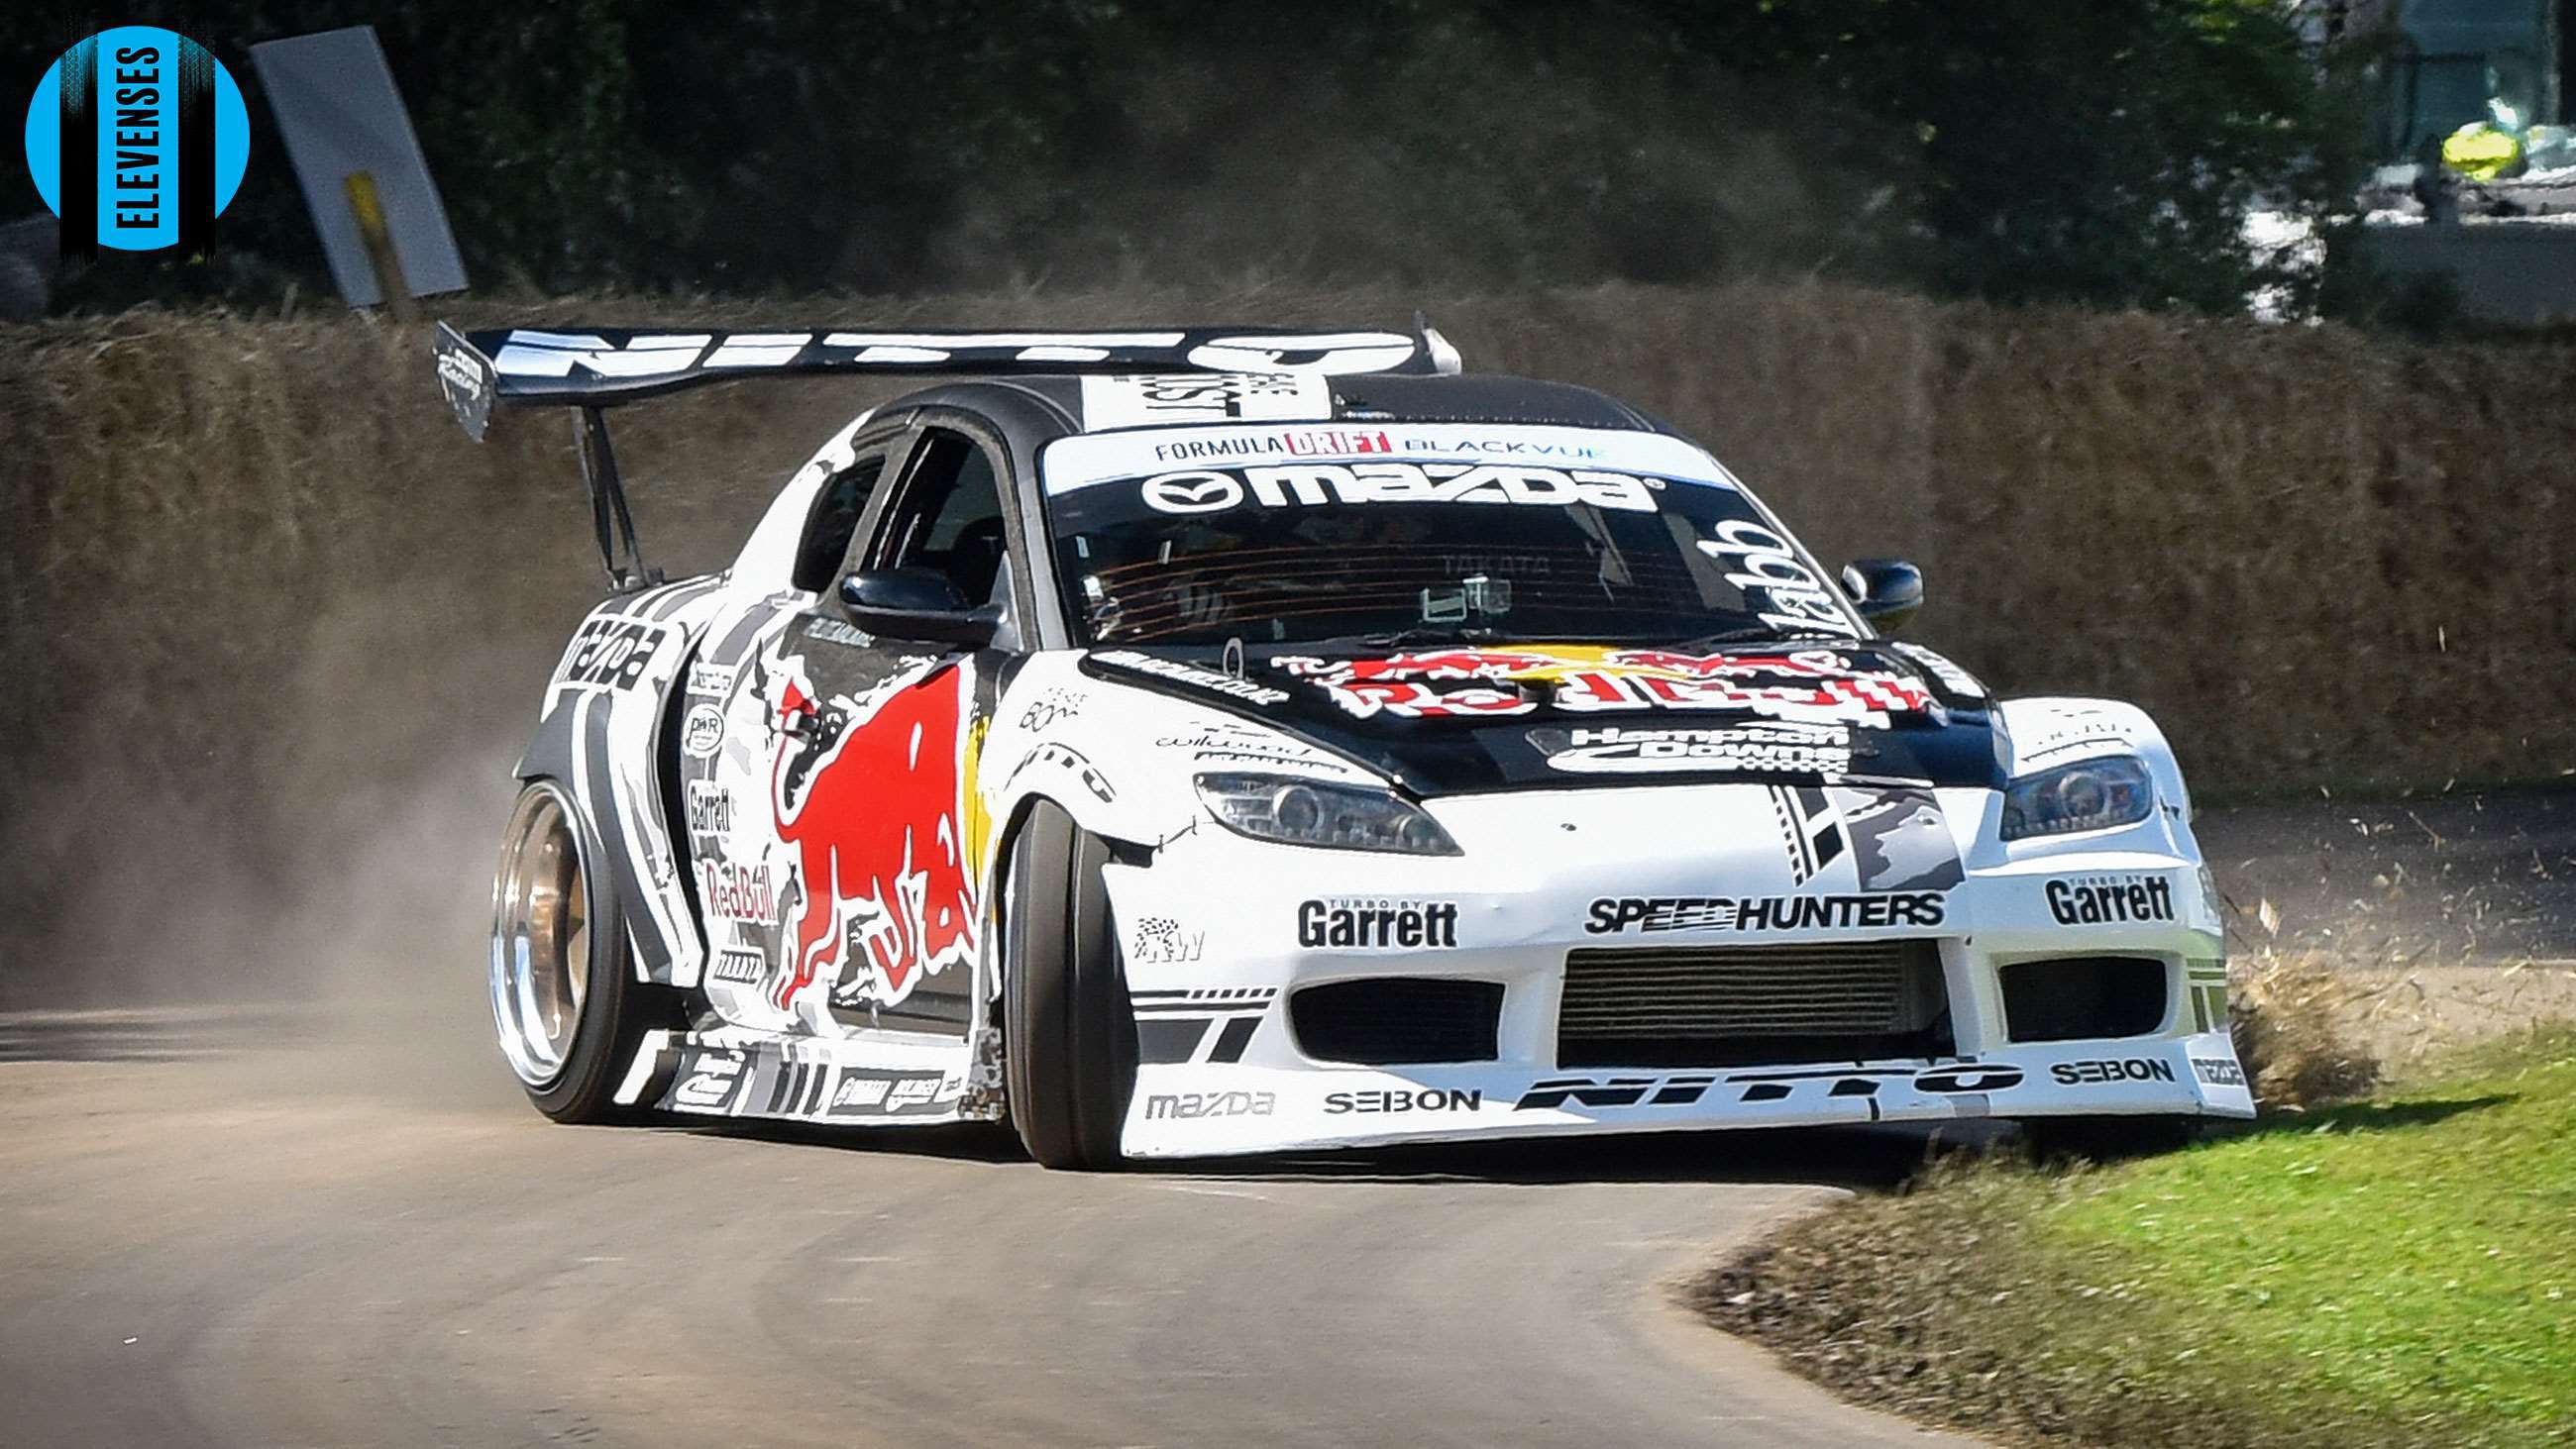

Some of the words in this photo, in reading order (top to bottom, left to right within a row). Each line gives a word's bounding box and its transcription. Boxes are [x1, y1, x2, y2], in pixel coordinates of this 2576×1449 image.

[494, 329, 1416, 377] NITTO
[1155, 435, 1284, 463] FORMULA
[1285, 430, 1391, 457] DRIFT
[1241, 462, 1659, 514] mazda
[706, 865, 743, 918] Red
[739, 862, 779, 923] Bull
[1329, 899, 1389, 909] TURBO
[1399, 899, 1423, 909] BY
[1584, 892, 1946, 934] SPEEDHUNTERS
[2045, 876, 2175, 926] Garrett
[1297, 898, 1459, 949] Garrett
[1513, 1064, 2024, 1111] NITTO
[2049, 1058, 2176, 1087] SEBON
[1145, 1090, 1276, 1120] mazda
[1324, 1089, 1481, 1115] SEBON
